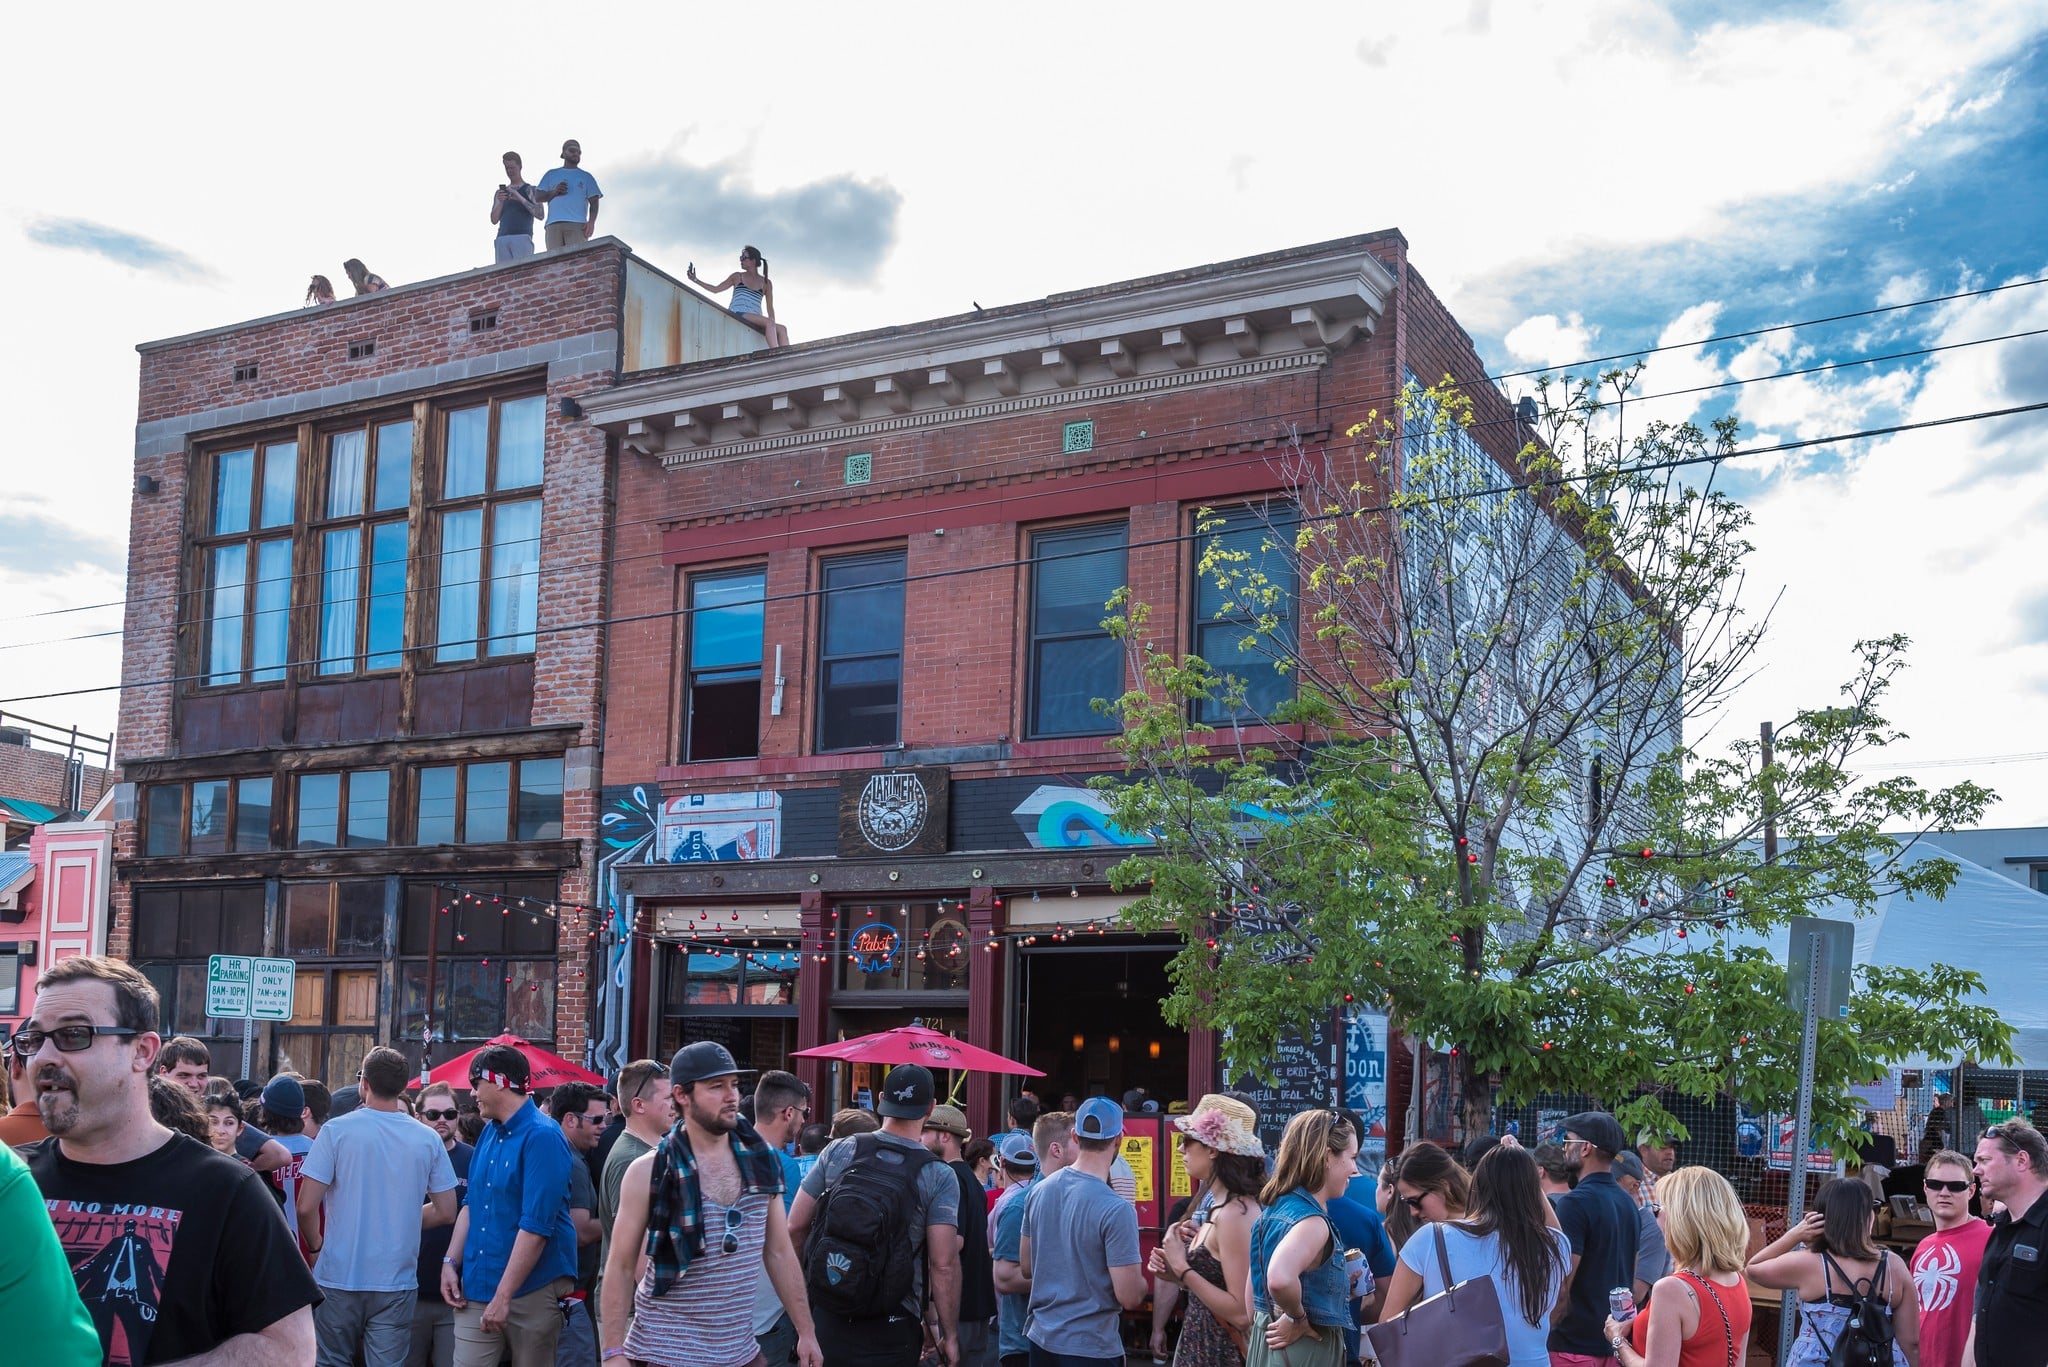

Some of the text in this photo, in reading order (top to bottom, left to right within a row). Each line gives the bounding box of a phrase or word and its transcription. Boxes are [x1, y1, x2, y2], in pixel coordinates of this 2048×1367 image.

[872, 775, 915, 803] LARIMER
[859, 934, 892, 952] Pabst
[211, 961, 219, 977] 2
[229, 960, 241, 969] HR
[256, 964, 291, 974] LOADING
[220, 970, 248, 980] PARKING
[262, 976, 283, 985] ONLY
[909, 1041, 962, 1054] JIM BEAM
[1346, 1053, 1381, 1078] bon
[67, 1200, 101, 1214] NO
[111, 1203, 182, 1222] MORE
